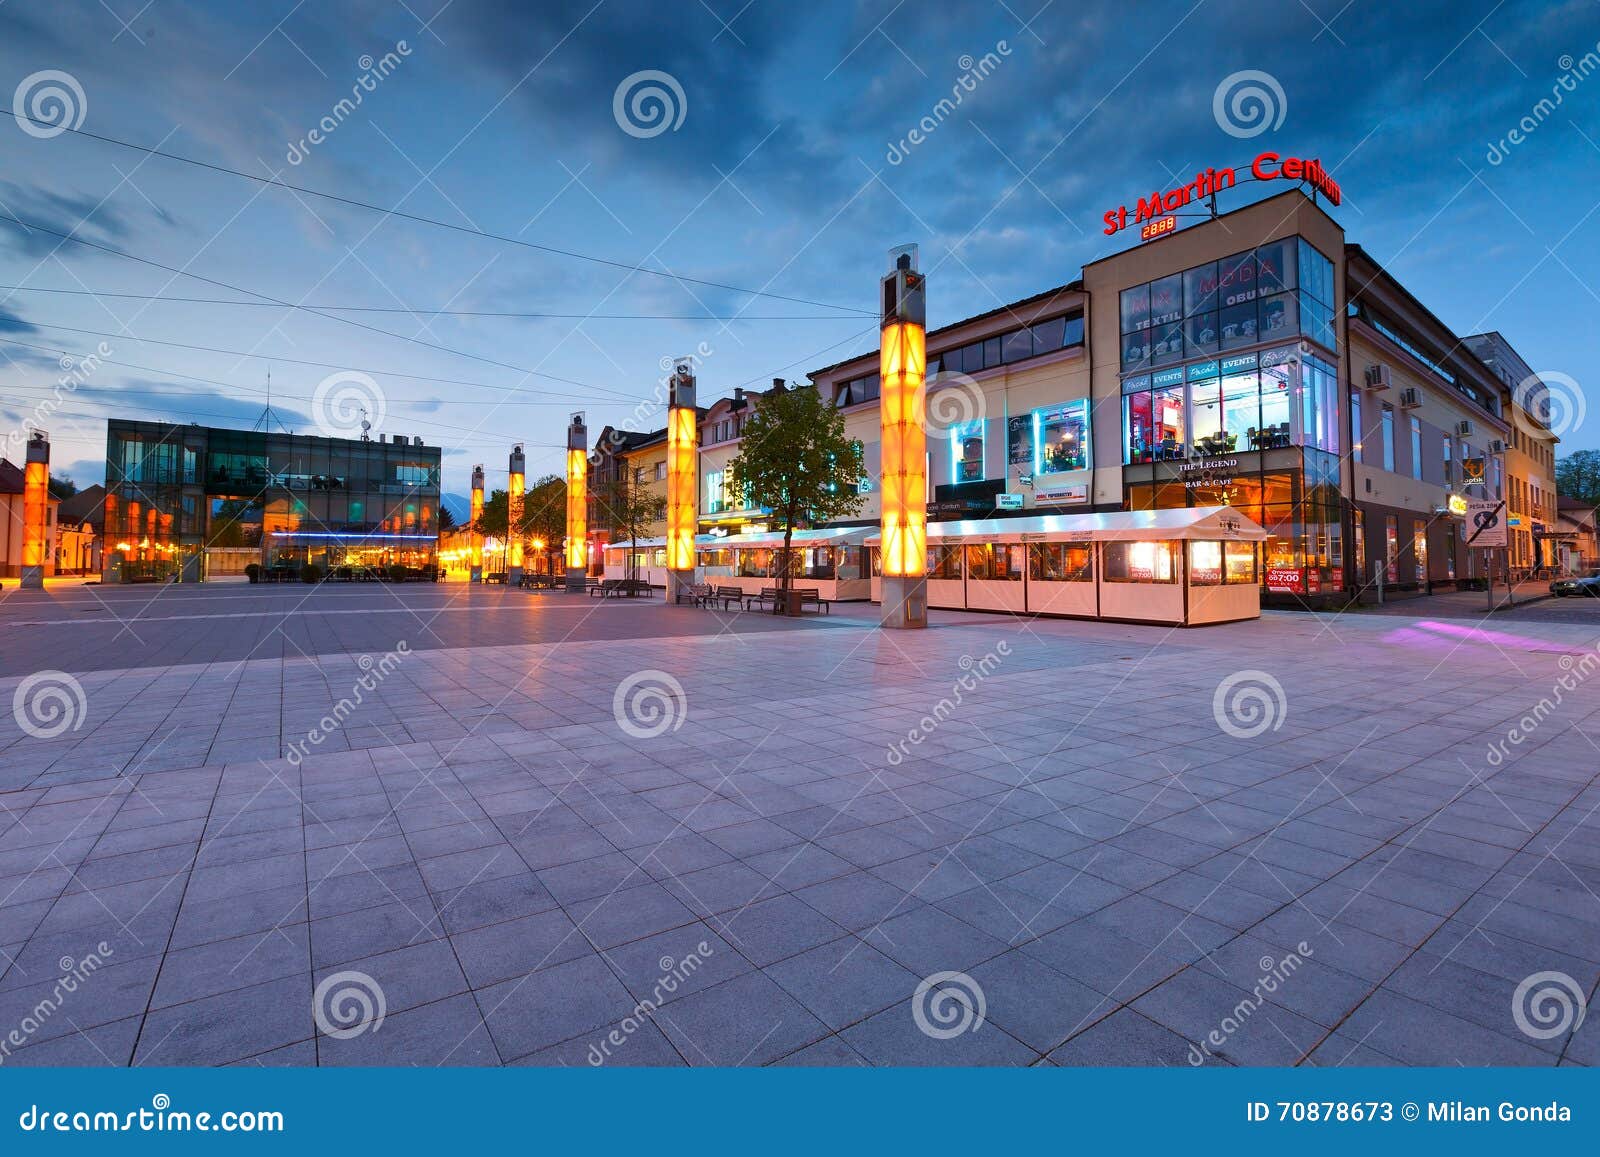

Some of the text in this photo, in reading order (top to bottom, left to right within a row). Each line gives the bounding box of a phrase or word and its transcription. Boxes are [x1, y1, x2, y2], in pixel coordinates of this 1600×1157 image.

[1103, 151, 1341, 236] St Martin Centrum
[1135, 311, 1181, 330] TEXTIL
[1223, 356, 1257, 369] EVENTS
[1153, 373, 1182, 384] EVENTS
[1179, 459, 1238, 471] THE LEGEND
[1185, 480, 1202, 488] BAR
[1278, 574, 1299, 582] 7:00
